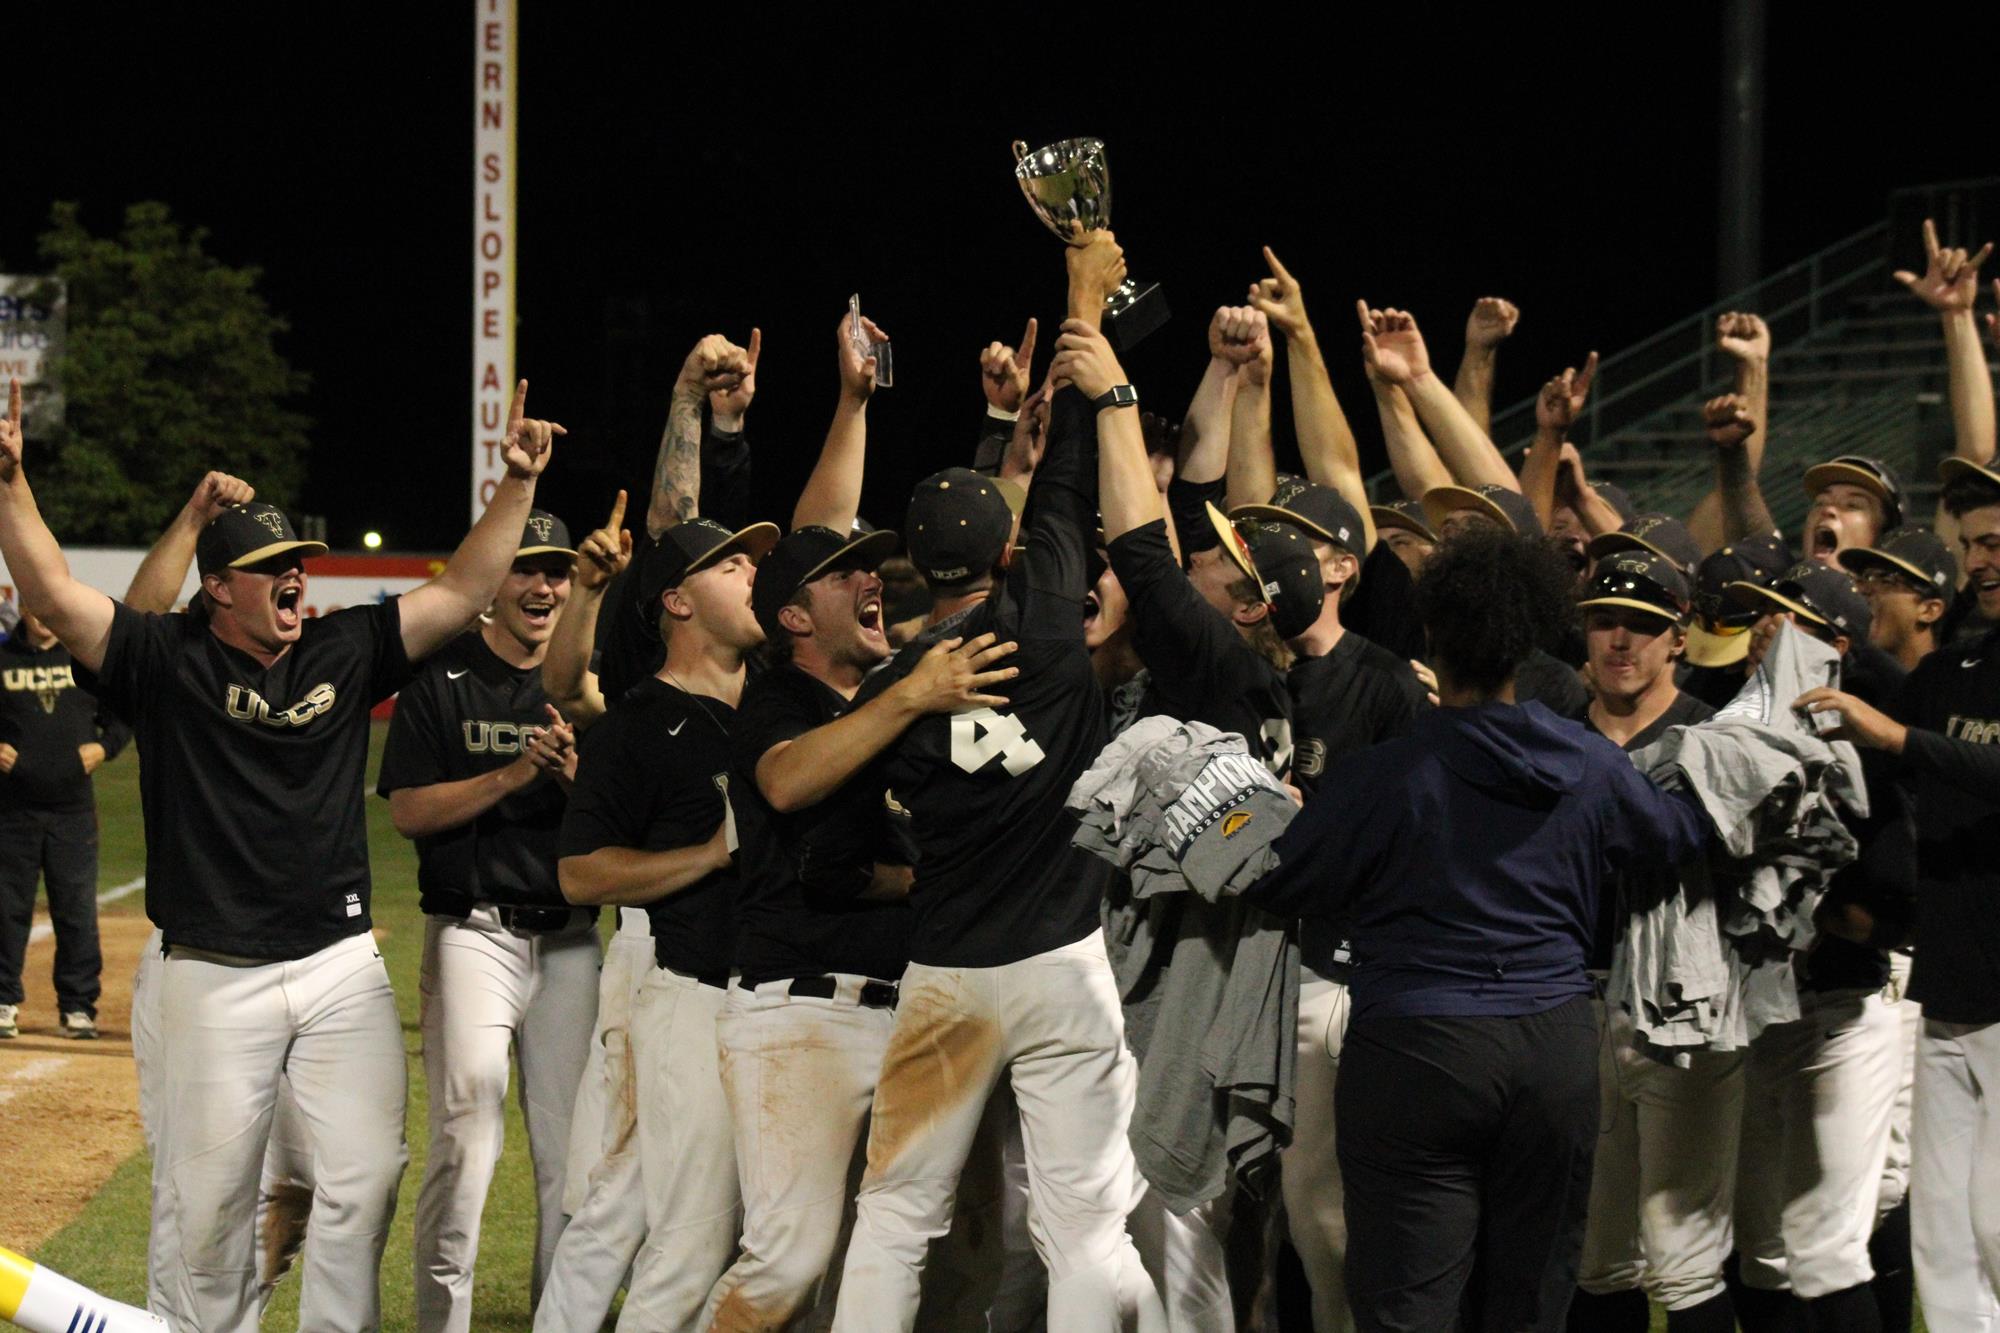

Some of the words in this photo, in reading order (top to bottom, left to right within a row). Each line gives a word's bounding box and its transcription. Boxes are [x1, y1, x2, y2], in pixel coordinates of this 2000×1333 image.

[481, 153, 502, 337] SLOPE
[480, 363, 500, 507] AUTO
[226, 682, 337, 727] UCCS
[463, 719, 553, 754] UCC
